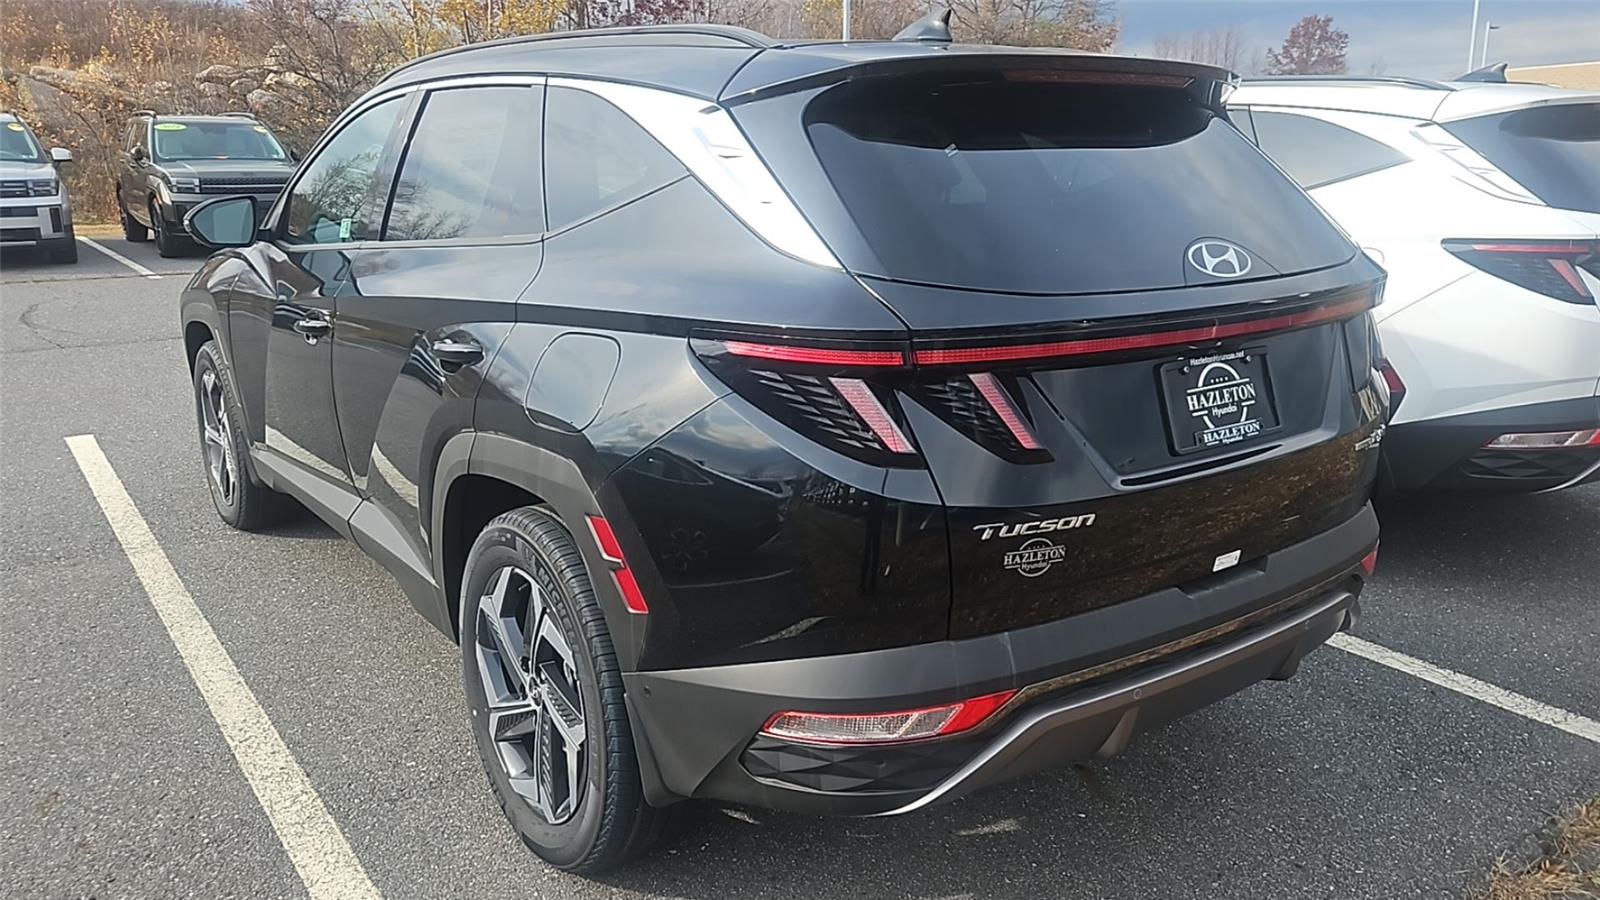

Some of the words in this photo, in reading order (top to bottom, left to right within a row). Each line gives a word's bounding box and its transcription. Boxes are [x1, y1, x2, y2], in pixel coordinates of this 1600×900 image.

[1186, 383, 1256, 411] HAZLETON
[1212, 403, 1238, 418] Hyundai
[1203, 421, 1260, 442] HAZLETON
[1003, 547, 1066, 565] HAZLETON
